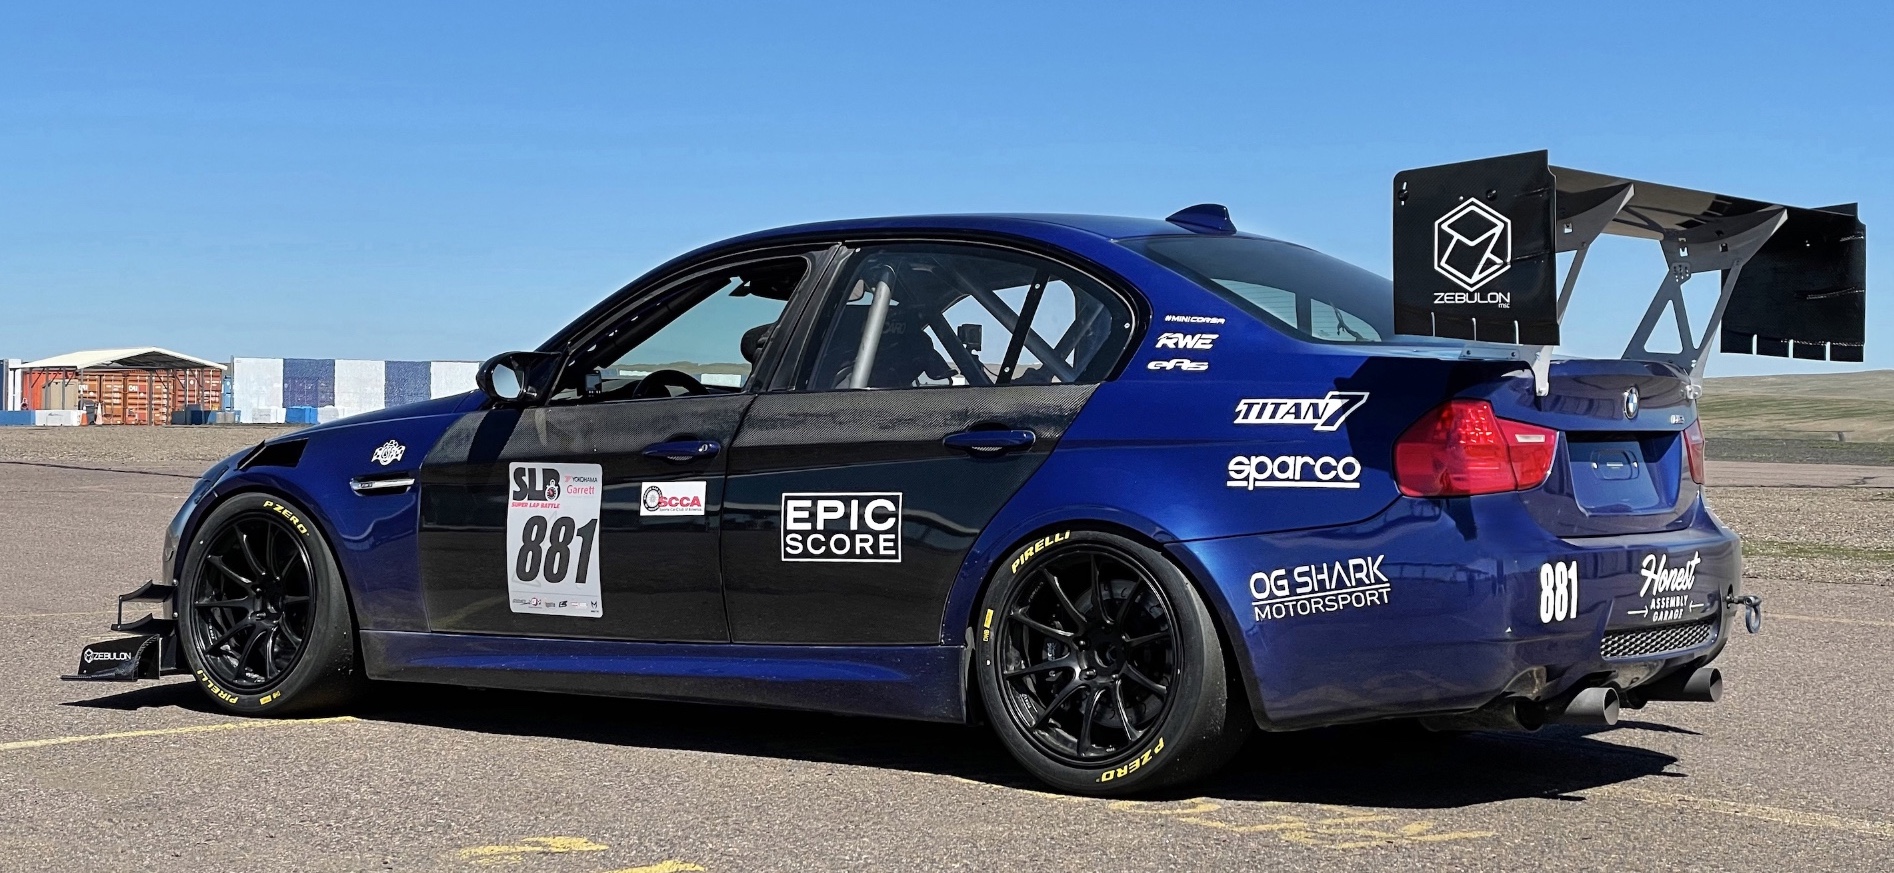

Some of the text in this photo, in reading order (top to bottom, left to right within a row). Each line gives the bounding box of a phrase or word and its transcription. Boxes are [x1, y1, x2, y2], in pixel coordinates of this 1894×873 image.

[1433, 292, 1511, 304] ZEBULON
[1155, 332, 1220, 349] RWE
[512, 467, 561, 501] SLB
[566, 484, 595, 495] Garrett
[1228, 455, 1362, 491] sparco
[658, 495, 702, 507] SCCA
[786, 498, 896, 531] EPIC
[515, 515, 599, 583] 881
[785, 533, 896, 555] SCORE
[1011, 530, 1070, 574] PIRELLI
[1250, 554, 1389, 600] OG SHARK
[1640, 550, 1701, 598] Honest
[1254, 587, 1391, 622] MOTORSPORT
[1540, 560, 1578, 624] 881
[1649, 594, 1688, 610] ASSEMBLY
[1652, 608, 1684, 622] GARAGE
[92, 652, 132, 660] ZEBULON
[197, 669, 239, 704] PIRELLI
